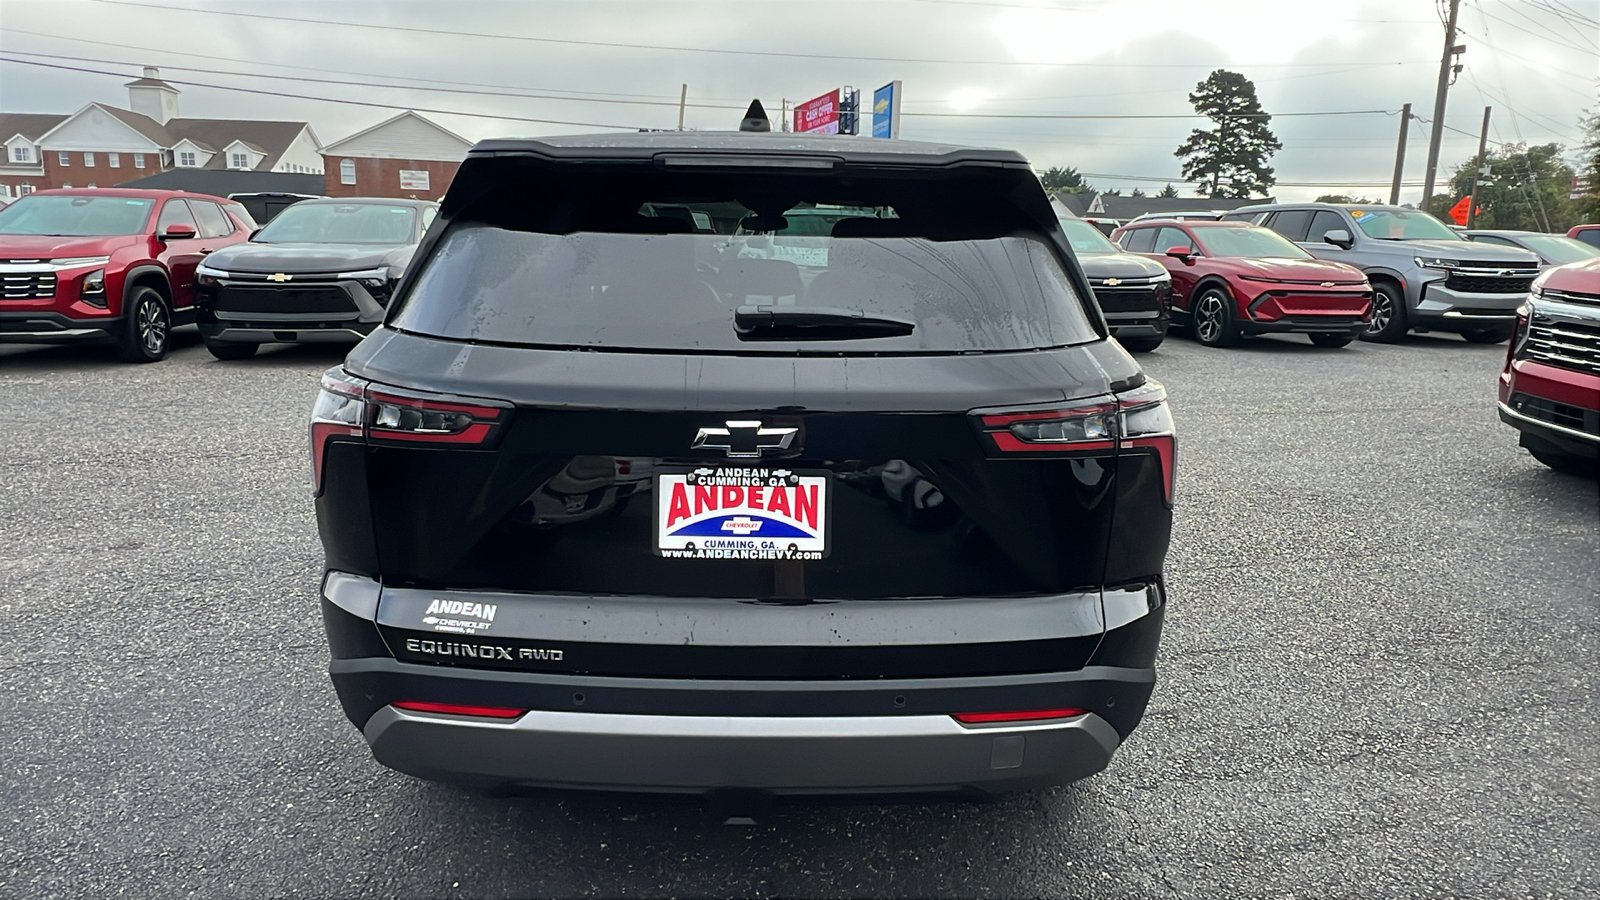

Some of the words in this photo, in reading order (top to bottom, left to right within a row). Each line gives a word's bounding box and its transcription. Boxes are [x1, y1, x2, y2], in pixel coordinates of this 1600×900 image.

[806, 108, 818, 122] CASH
[818, 101, 833, 117] OFFER
[715, 468, 769, 477] ANDEAN
[697, 477, 765, 486] CUMMING,
[769, 479, 787, 487] GA
[666, 482, 819, 532] ANDEAN
[704, 540, 758, 550] CUMMING,
[761, 541, 779, 549] GA.
[661, 550, 822, 560] www.ANDEANCHEVY.com
[426, 599, 498, 621] ANDEAN
[438, 618, 492, 630] CHEVROLET
[406, 638, 514, 661] EQUINOX
[519, 648, 563, 661] AWD
